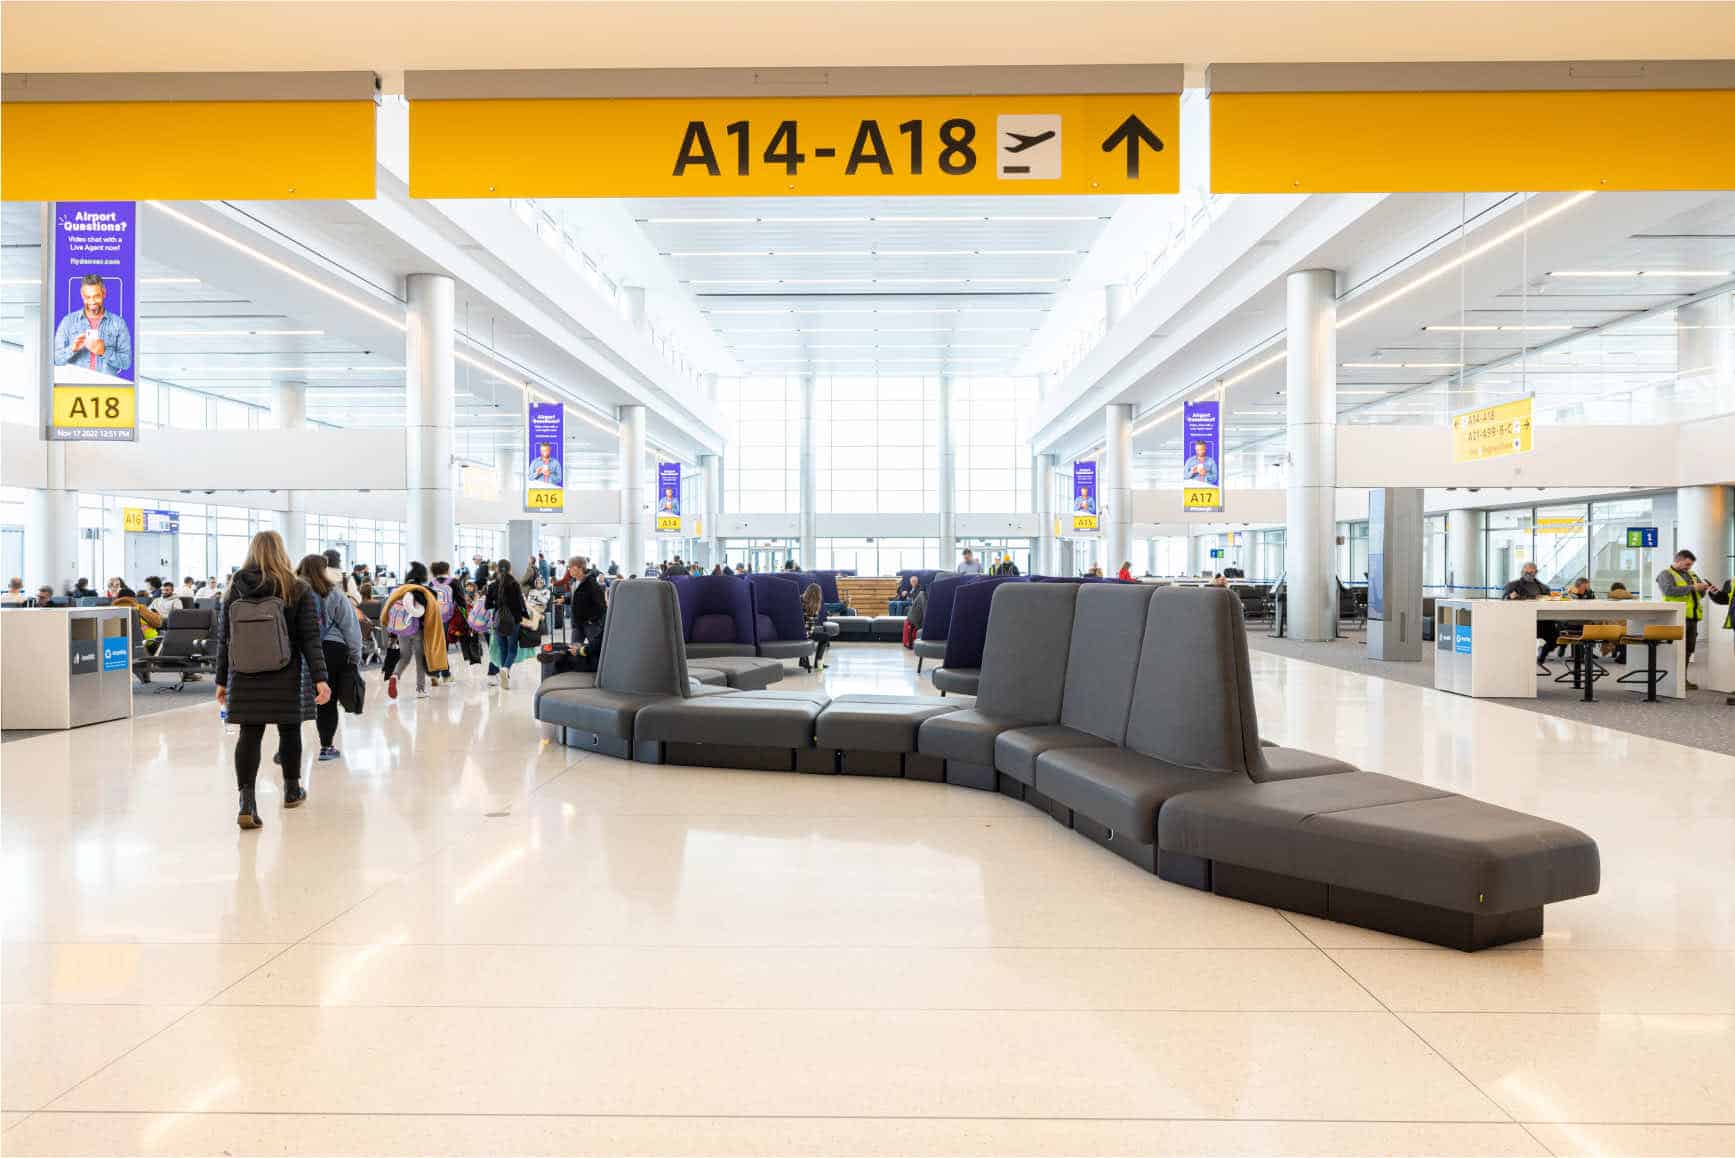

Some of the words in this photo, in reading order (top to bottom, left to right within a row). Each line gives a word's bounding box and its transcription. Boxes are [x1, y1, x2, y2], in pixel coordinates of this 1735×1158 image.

[672, 118, 977, 176] A14-A18
[75, 211, 116, 223] Airport
[64, 222, 127, 231] Questions?
[69, 397, 120, 418] A18
[535, 493, 558, 504] A16
[1190, 493, 1213, 503] A17
[126, 513, 142, 526] A16
